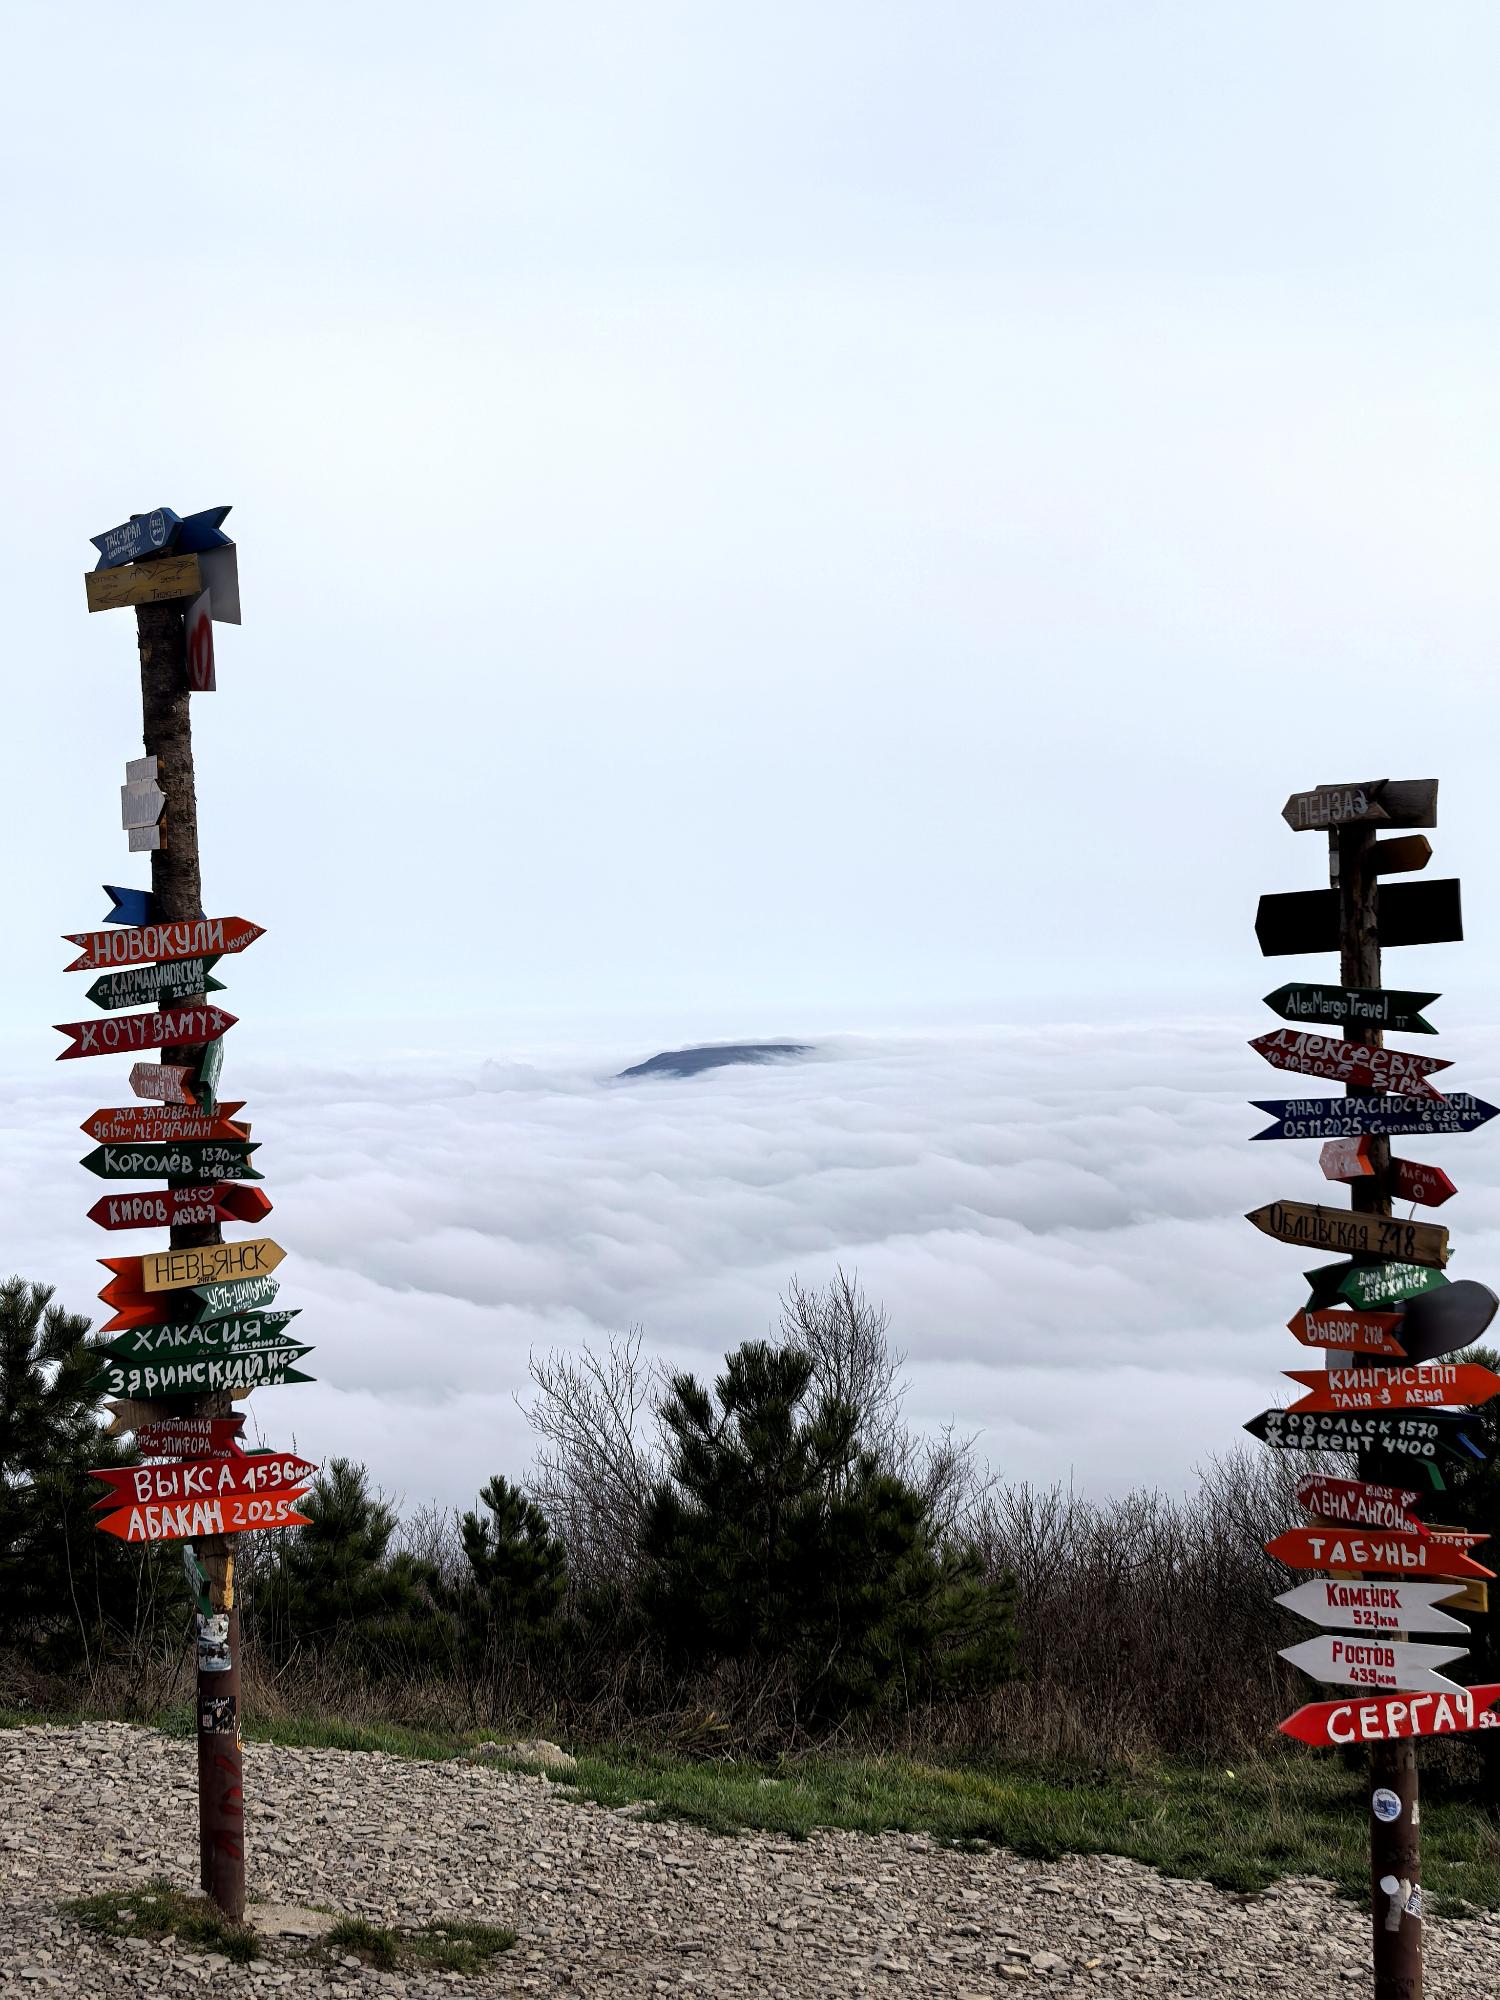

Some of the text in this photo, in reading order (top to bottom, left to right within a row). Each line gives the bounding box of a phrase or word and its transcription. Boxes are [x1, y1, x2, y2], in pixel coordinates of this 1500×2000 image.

[1298, 790, 1354, 825] ПЕНЗА
[93, 920, 224, 964] НОВОКУЛИ
[111, 958, 205, 995] КАРМАЛИНОВСКАЯ
[81, 1016, 147, 1051] ХОЧУ
[1284, 1101, 1323, 1118] ЯНАО
[109, 1199, 168, 1224] КИРОВ
[155, 1244, 268, 1283] НЕВЬЯНСК
[132, 1311, 293, 1352] ХАКАСИЯ 2025
[1328, 1367, 1457, 1390] КИНГИСЕПП
[1331, 1392, 1372, 1408] ТАНЯ
[162, 1436, 211, 1454] ЭПИФОРА
[1399, 1420, 1439, 1440] 1570
[1382, 1436, 1436, 1457] 4400
[133, 1464, 236, 1503] ВЫКСА
[127, 1499, 289, 1541] АБАКАН 2025
[1310, 1491, 1350, 1520] ЛЕНА
[1308, 1538, 1426, 1567] ТАБУНЫ
[1326, 1692, 1474, 1744] СЕРГАЧ
